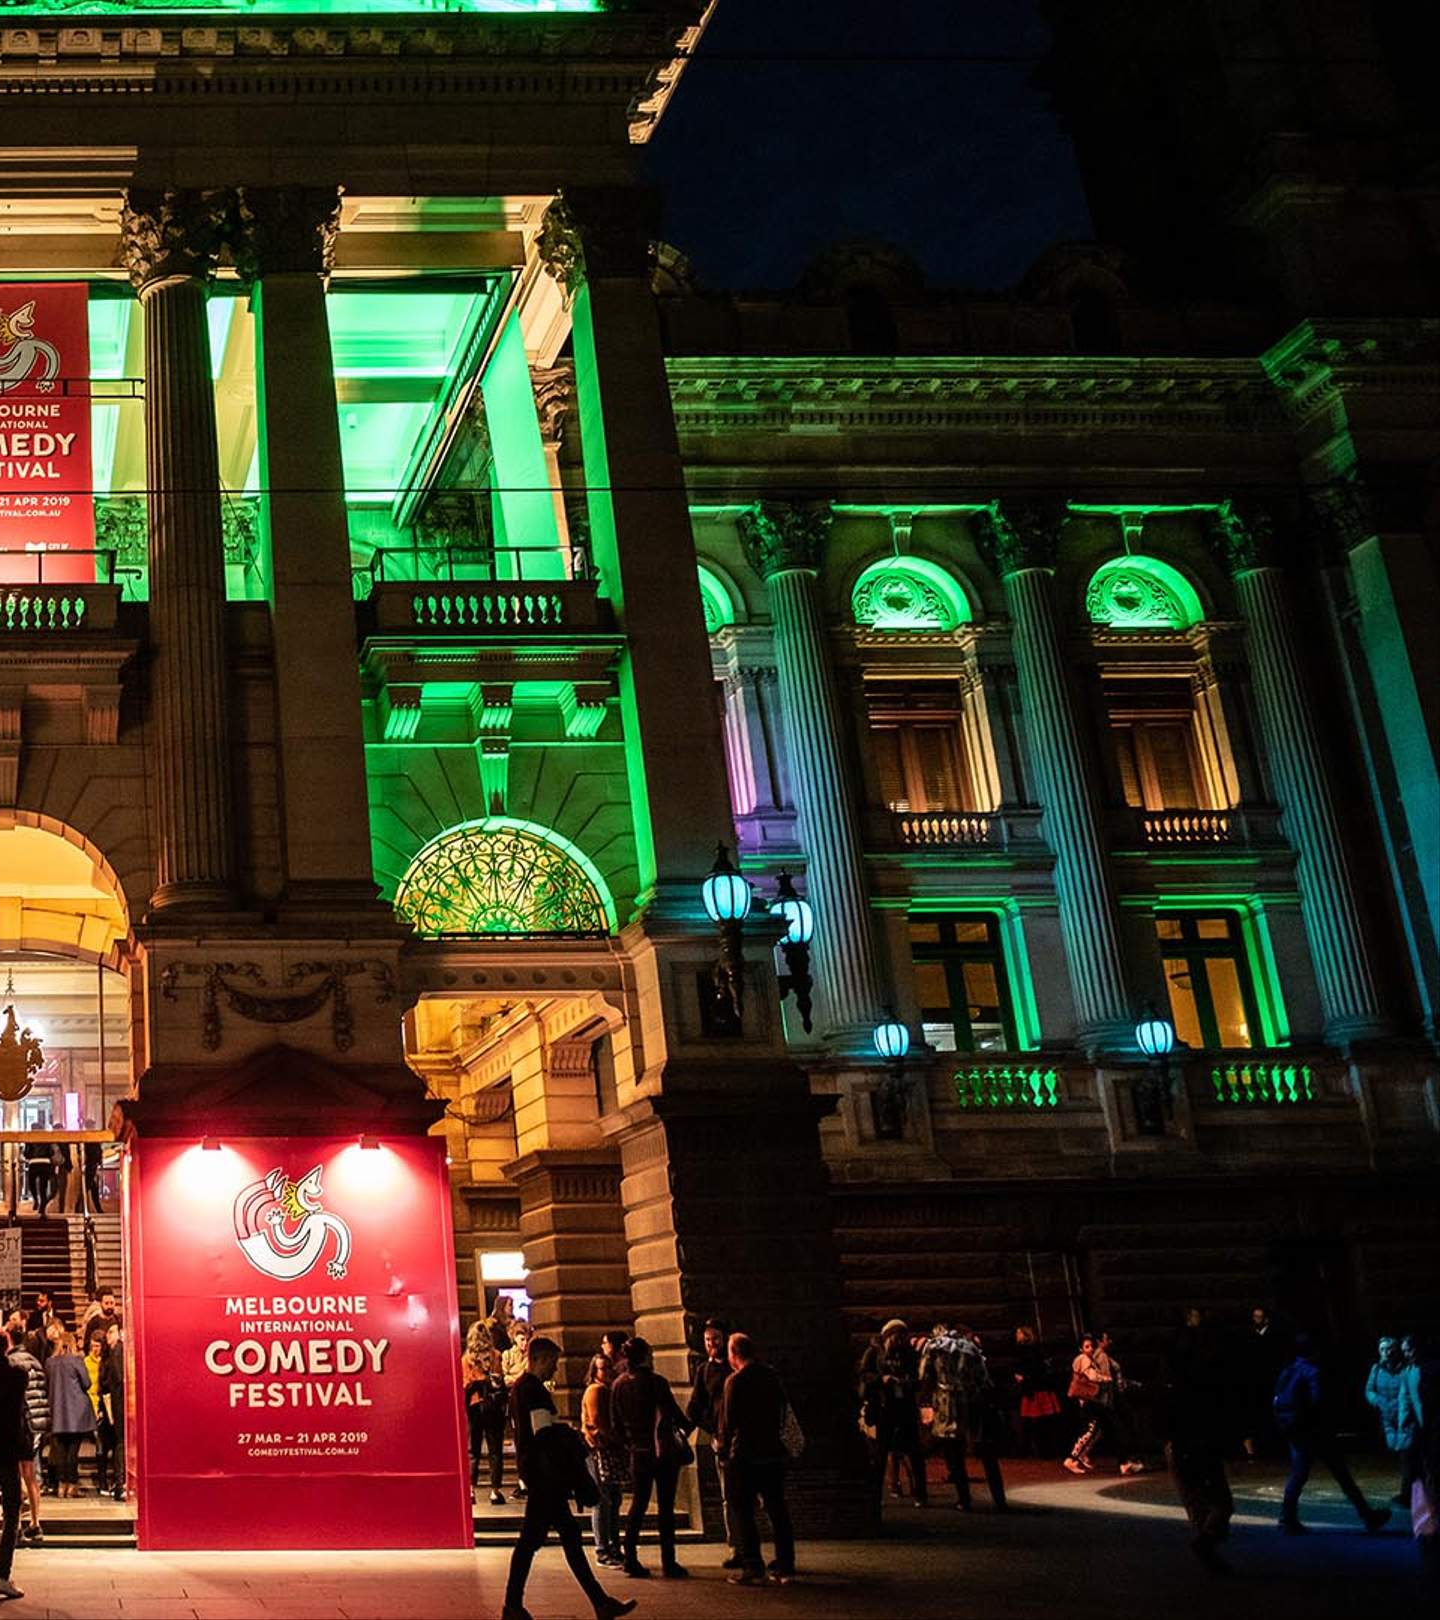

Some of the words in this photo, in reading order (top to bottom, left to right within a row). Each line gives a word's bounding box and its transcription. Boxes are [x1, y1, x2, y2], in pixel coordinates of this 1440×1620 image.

[14, 496, 38, 506] APR
[42, 496, 71, 507] 2019
[225, 1296, 368, 1316] MELBOURNE
[240, 1319, 354, 1333] INTERNATIONAL
[204, 1338, 388, 1375] COMEDY
[229, 1381, 373, 1408] FESTIVAL
[238, 1433, 252, 1444] 27
[254, 1433, 282, 1444] MAR
[297, 1432, 309, 1443] 21
[312, 1433, 337, 1443] APR
[340, 1431, 368, 1443] 2019
[247, 1447, 360, 1457] COMEDYFESTIVAL.COM.AU
